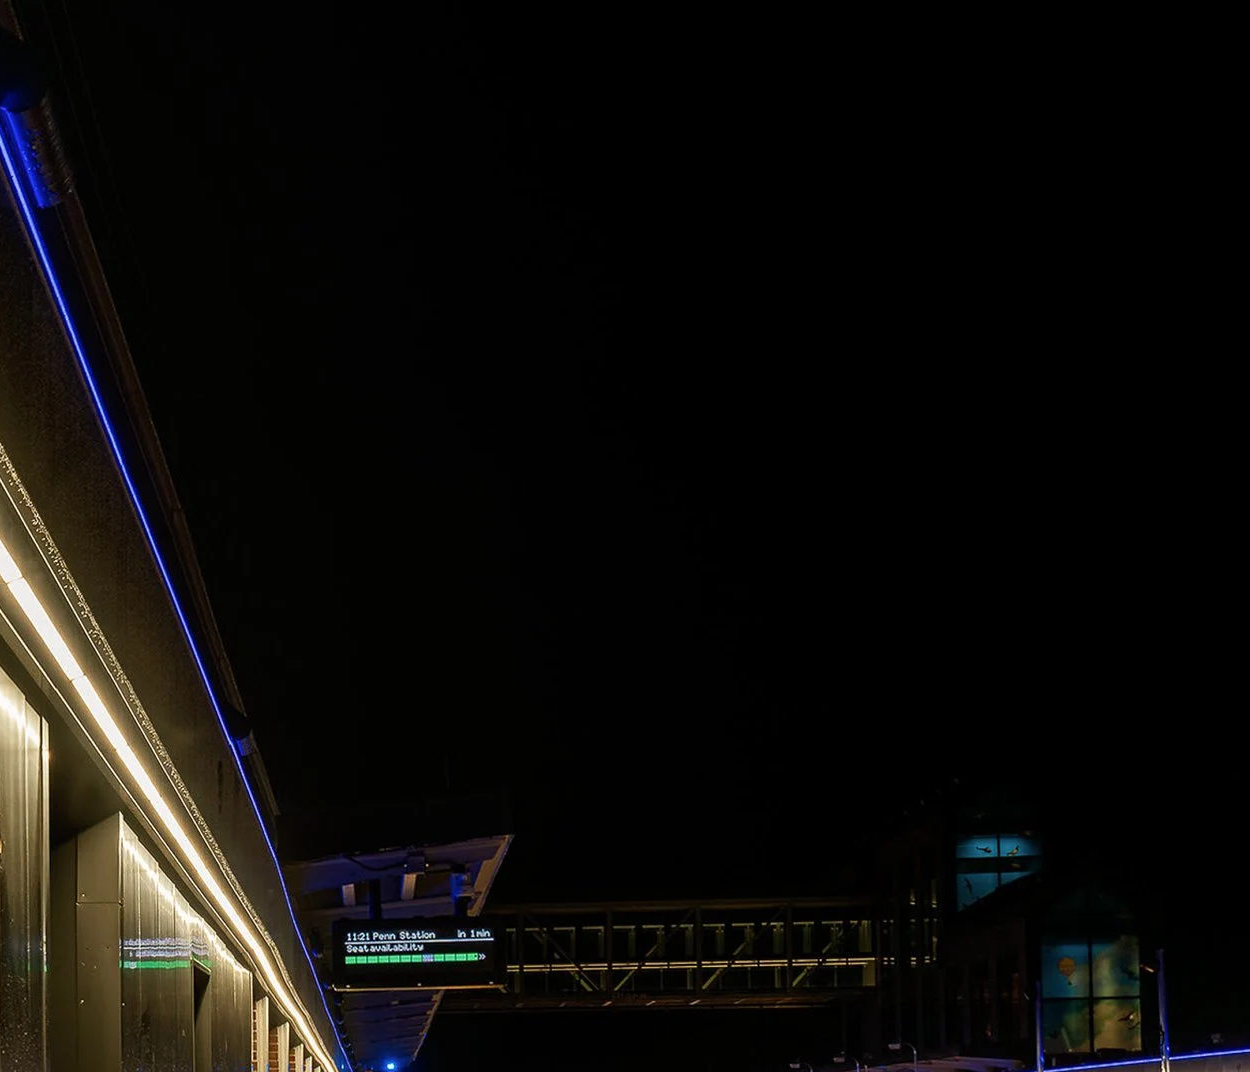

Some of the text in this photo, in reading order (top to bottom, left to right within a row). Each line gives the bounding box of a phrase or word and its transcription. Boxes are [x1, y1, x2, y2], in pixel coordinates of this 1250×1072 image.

[346, 932, 370, 941] 11:21
[372, 931, 396, 941] Penn
[399, 930, 436, 940] Station
[457, 929, 466, 938] in
